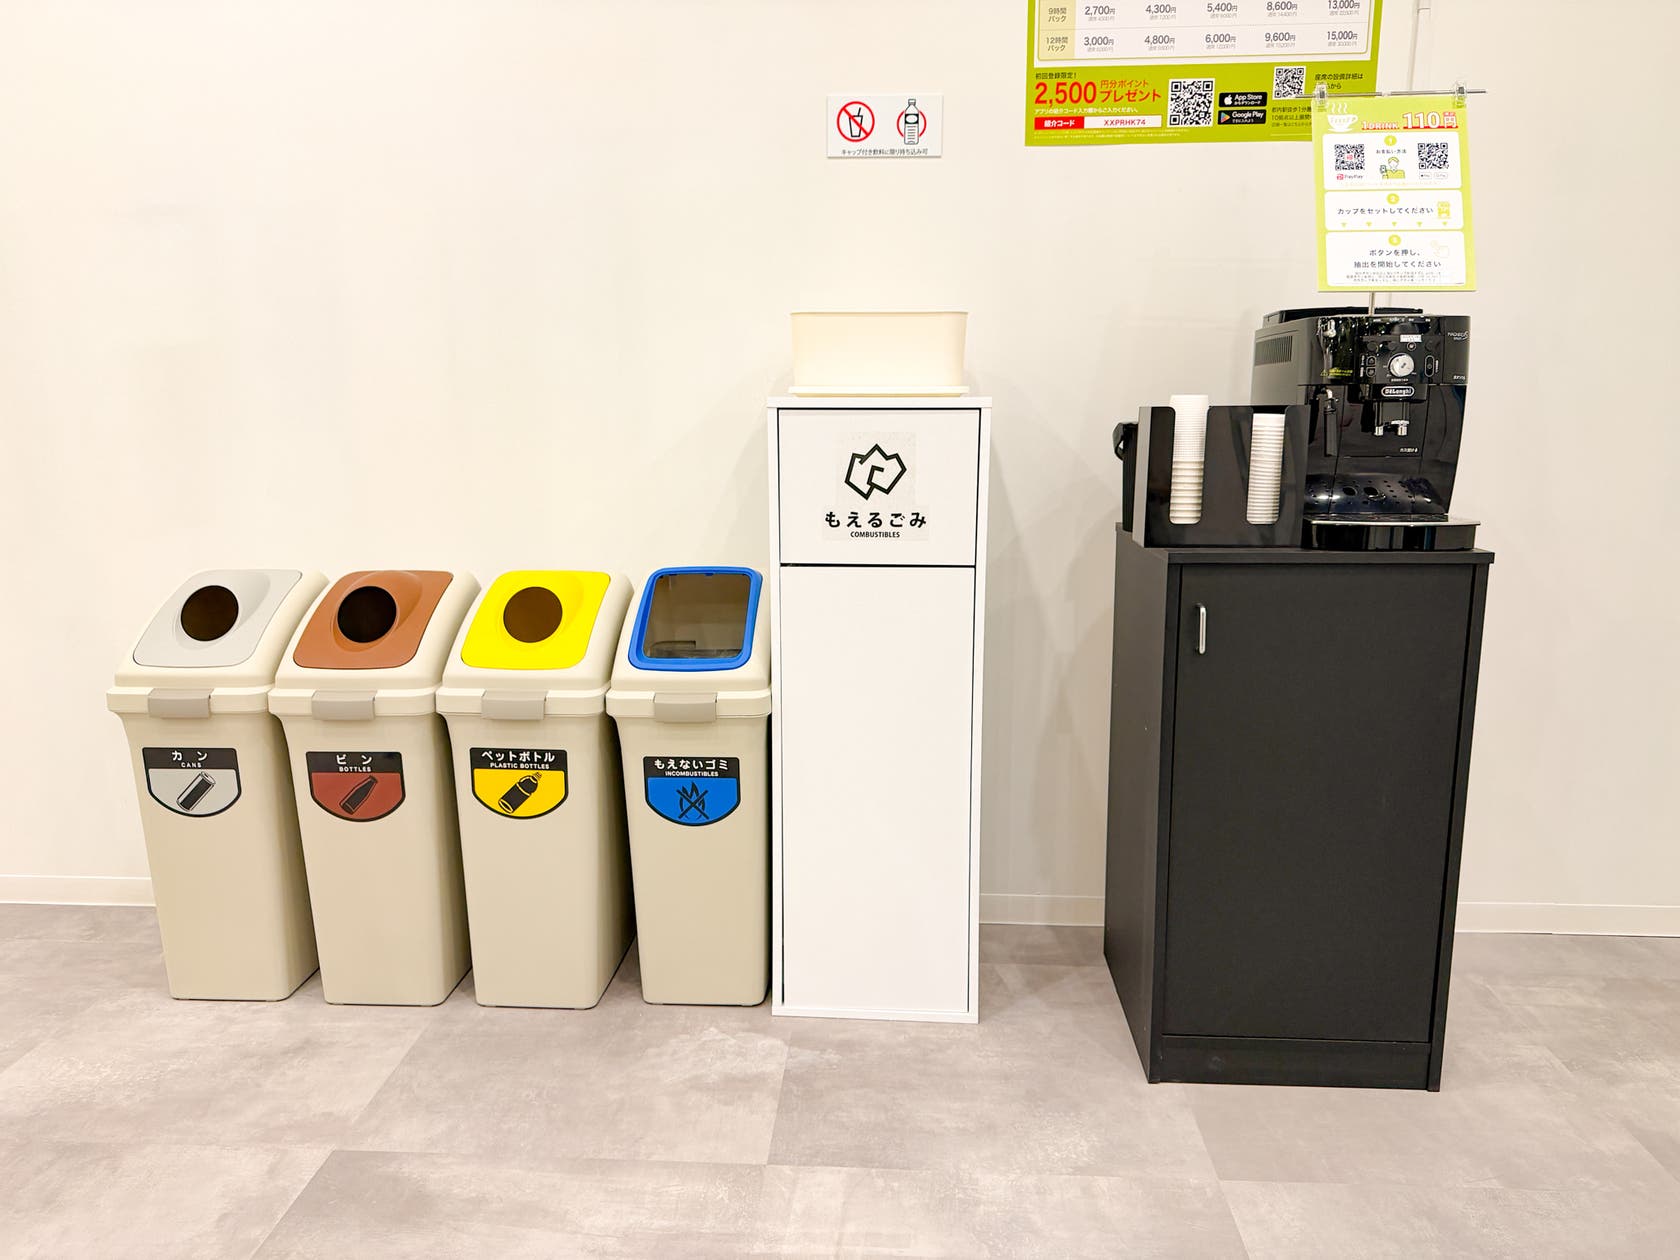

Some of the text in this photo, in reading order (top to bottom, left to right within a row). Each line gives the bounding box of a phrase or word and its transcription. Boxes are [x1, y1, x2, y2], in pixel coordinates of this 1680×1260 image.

[1146, 4, 1176, 15] 4,300円
[1207, 3, 1238, 13] 5,400円
[1266, 1, 1297, 11] 8,600円
[1328, 0, 1360, 10] 13,000円
[1048, 7, 1067, 15] 9時間
[1085, 6, 1115, 16] 2,700円
[1048, 15, 1067, 23] パック
[1046, 36, 1068, 44] 12時間
[1084, 36, 1114, 46] 3,000円
[1144, 35, 1175, 45] 4,800円
[1205, 33, 1236, 44] 6,000円
[1265, 32, 1296, 42] 9,600円
[1327, 31, 1358, 41] 15,000円
[1048, 44, 1066, 52] パック
[1100, 80, 1149, 89] 円分ポイント
[1035, 81, 1097, 107] 2,500
[1100, 89, 1162, 103] プレゼント
[1234, 94, 1247, 102] App
[1231, 111, 1265, 119] Google Play
[1044, 119, 1076, 128] 紹介コード
[1103, 119, 1147, 127] XXPRHK74
[841, 148, 928, 156] キャップ付き飲料に限り持ち込み可
[1337, 206, 1434, 215] カップをセットしてください
[1353, 260, 1442, 269] 抽出を開始してください
[825, 511, 926, 528] もえるごみ
[171, 750, 208, 761] カン
[481, 750, 555, 763] ペットボトル
[654, 759, 729, 771] もえないゴミ
